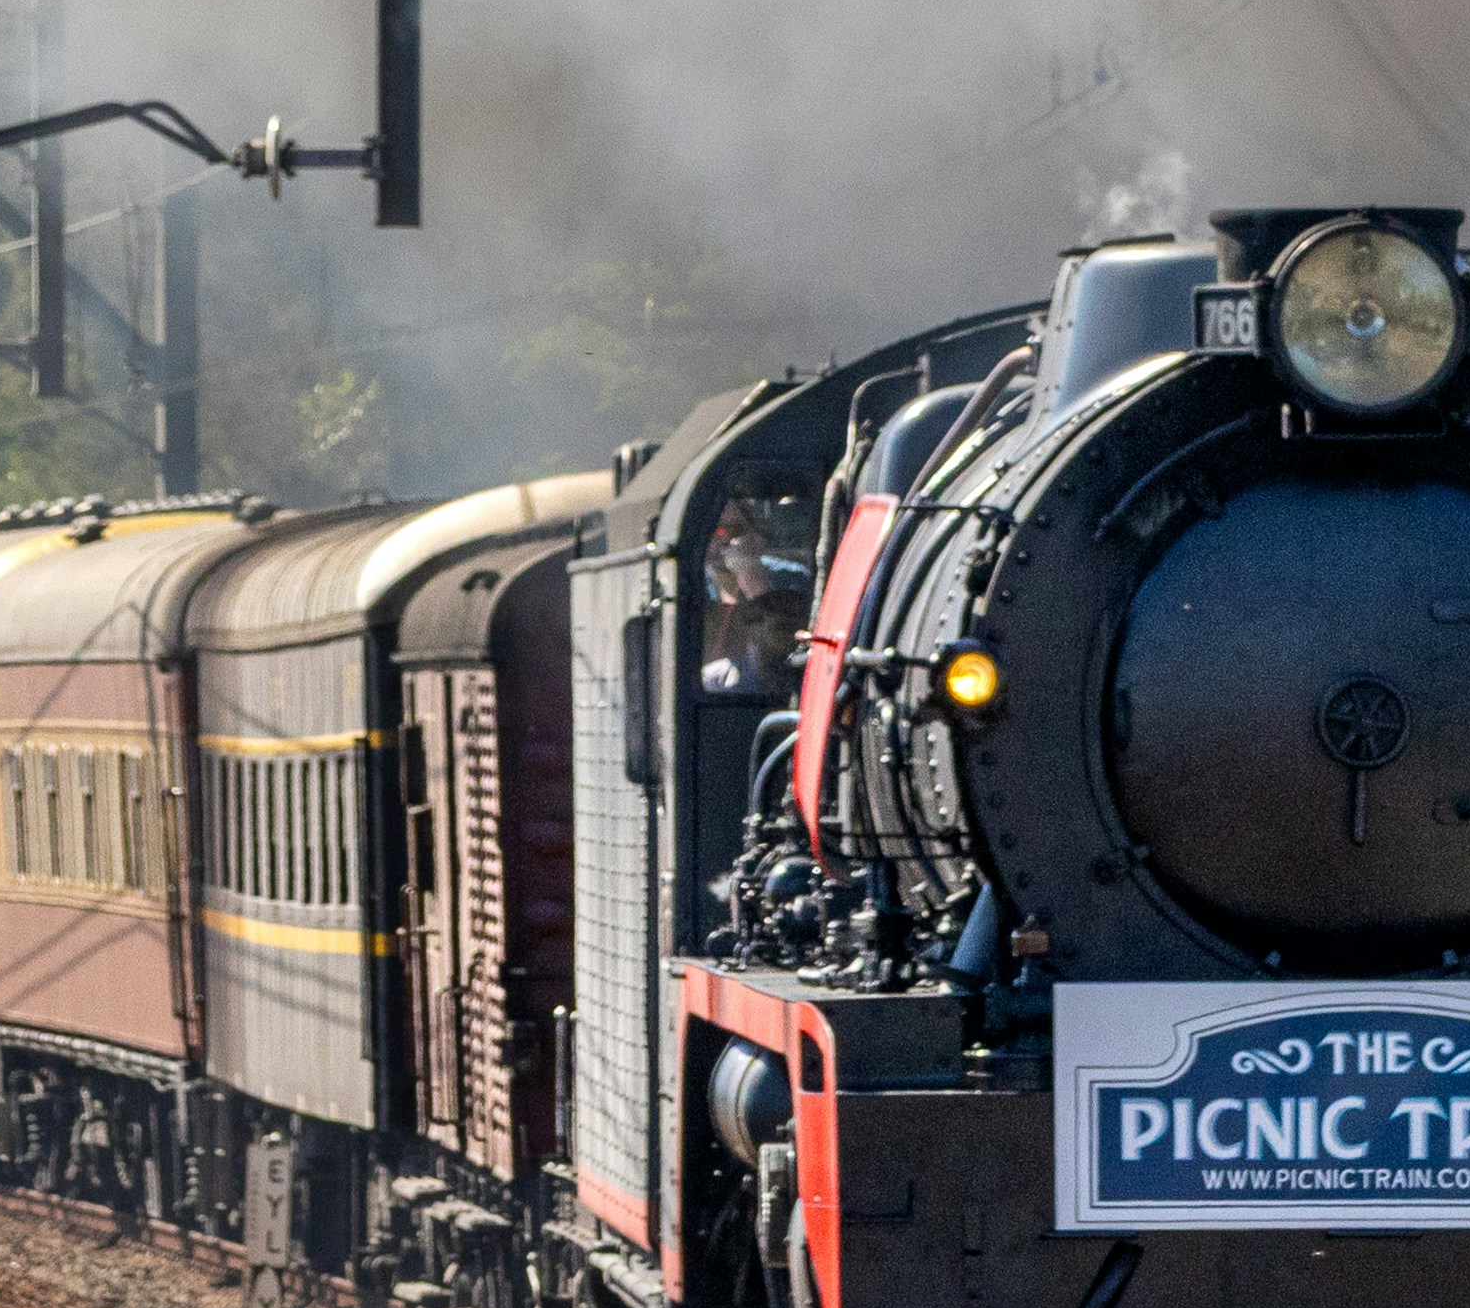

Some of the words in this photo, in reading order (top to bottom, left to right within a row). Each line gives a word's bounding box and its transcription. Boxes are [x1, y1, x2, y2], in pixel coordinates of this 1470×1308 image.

[1202, 299, 1257, 345] 766
[1318, 1032, 1415, 1074] THE
[1120, 1095, 1368, 1162] PICNIC
